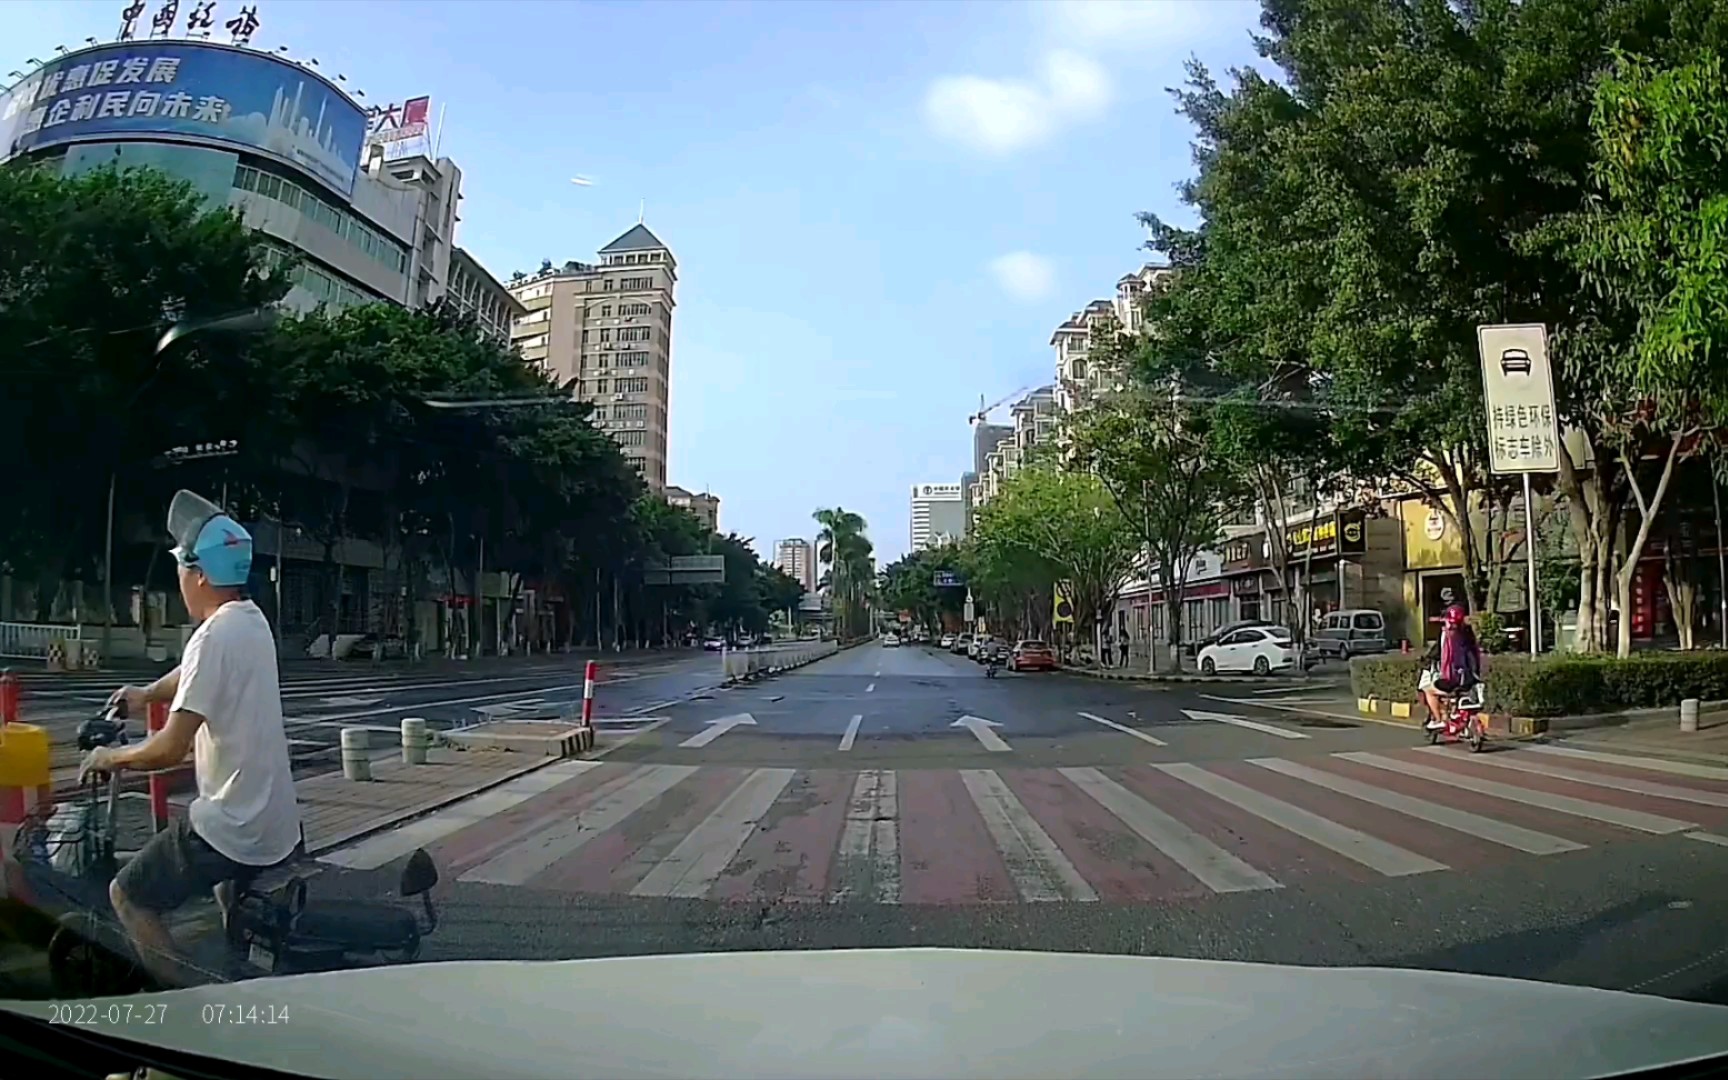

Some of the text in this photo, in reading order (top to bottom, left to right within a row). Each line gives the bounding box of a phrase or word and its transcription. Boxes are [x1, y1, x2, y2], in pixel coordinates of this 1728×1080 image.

[1492, 404, 1552, 430] 持绿色环保
[1494, 434, 1555, 460] 标志车除外
